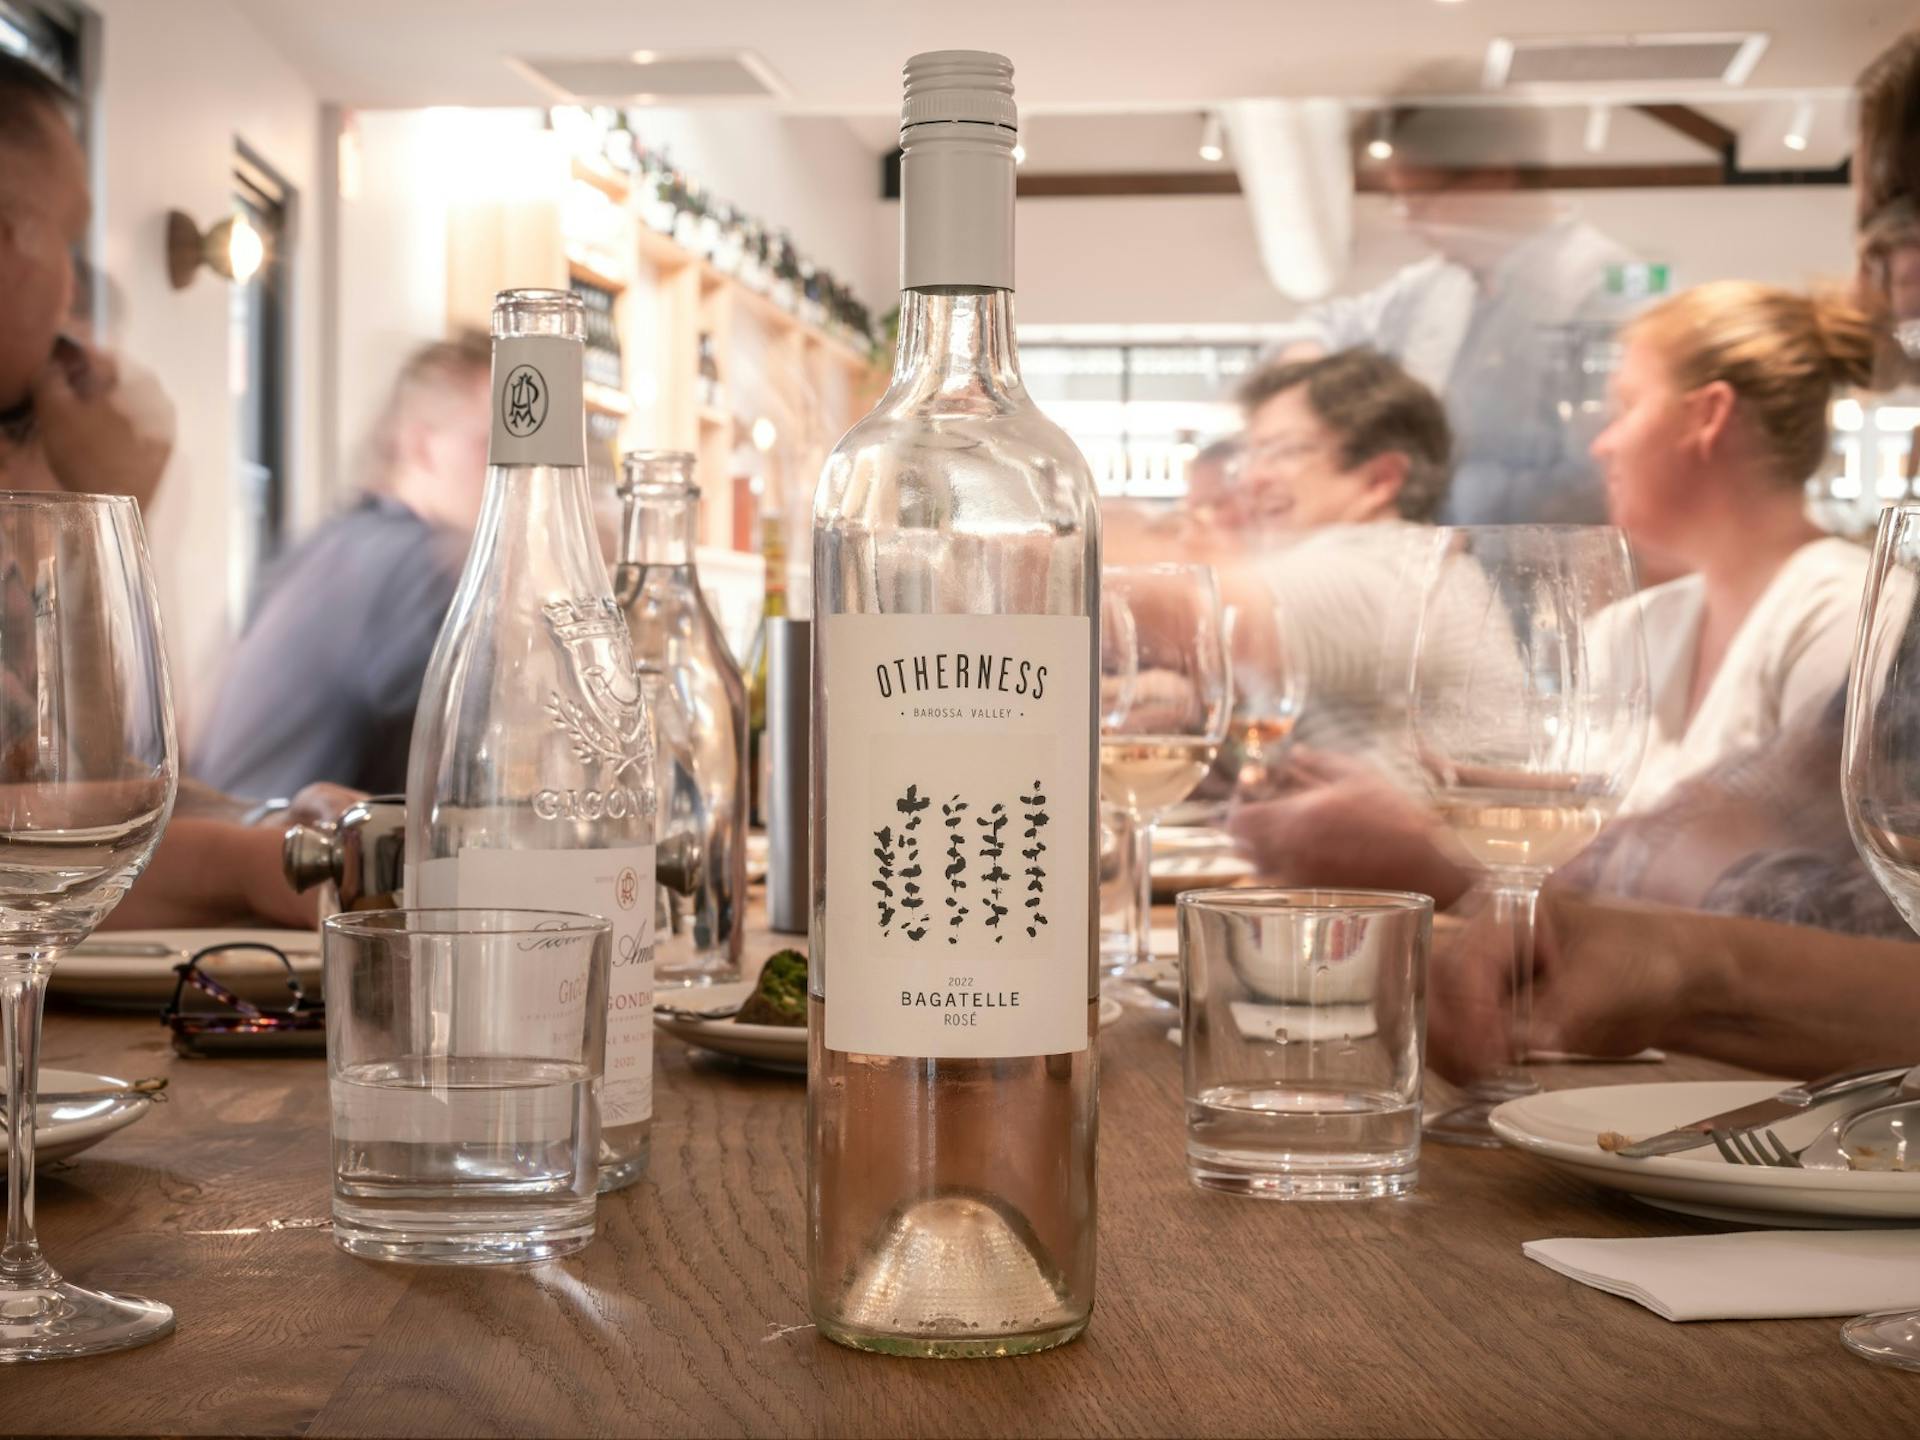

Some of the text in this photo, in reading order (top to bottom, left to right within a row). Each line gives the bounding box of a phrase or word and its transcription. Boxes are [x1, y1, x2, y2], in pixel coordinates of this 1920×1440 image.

[876, 653, 1049, 701] OTHERNESS
[913, 707, 1012, 719] BAROSSA VALLEY
[948, 976, 974, 987] 2022
[901, 990, 1020, 1008] BAGATELLE
[944, 1010, 977, 1027] ROSÉ
